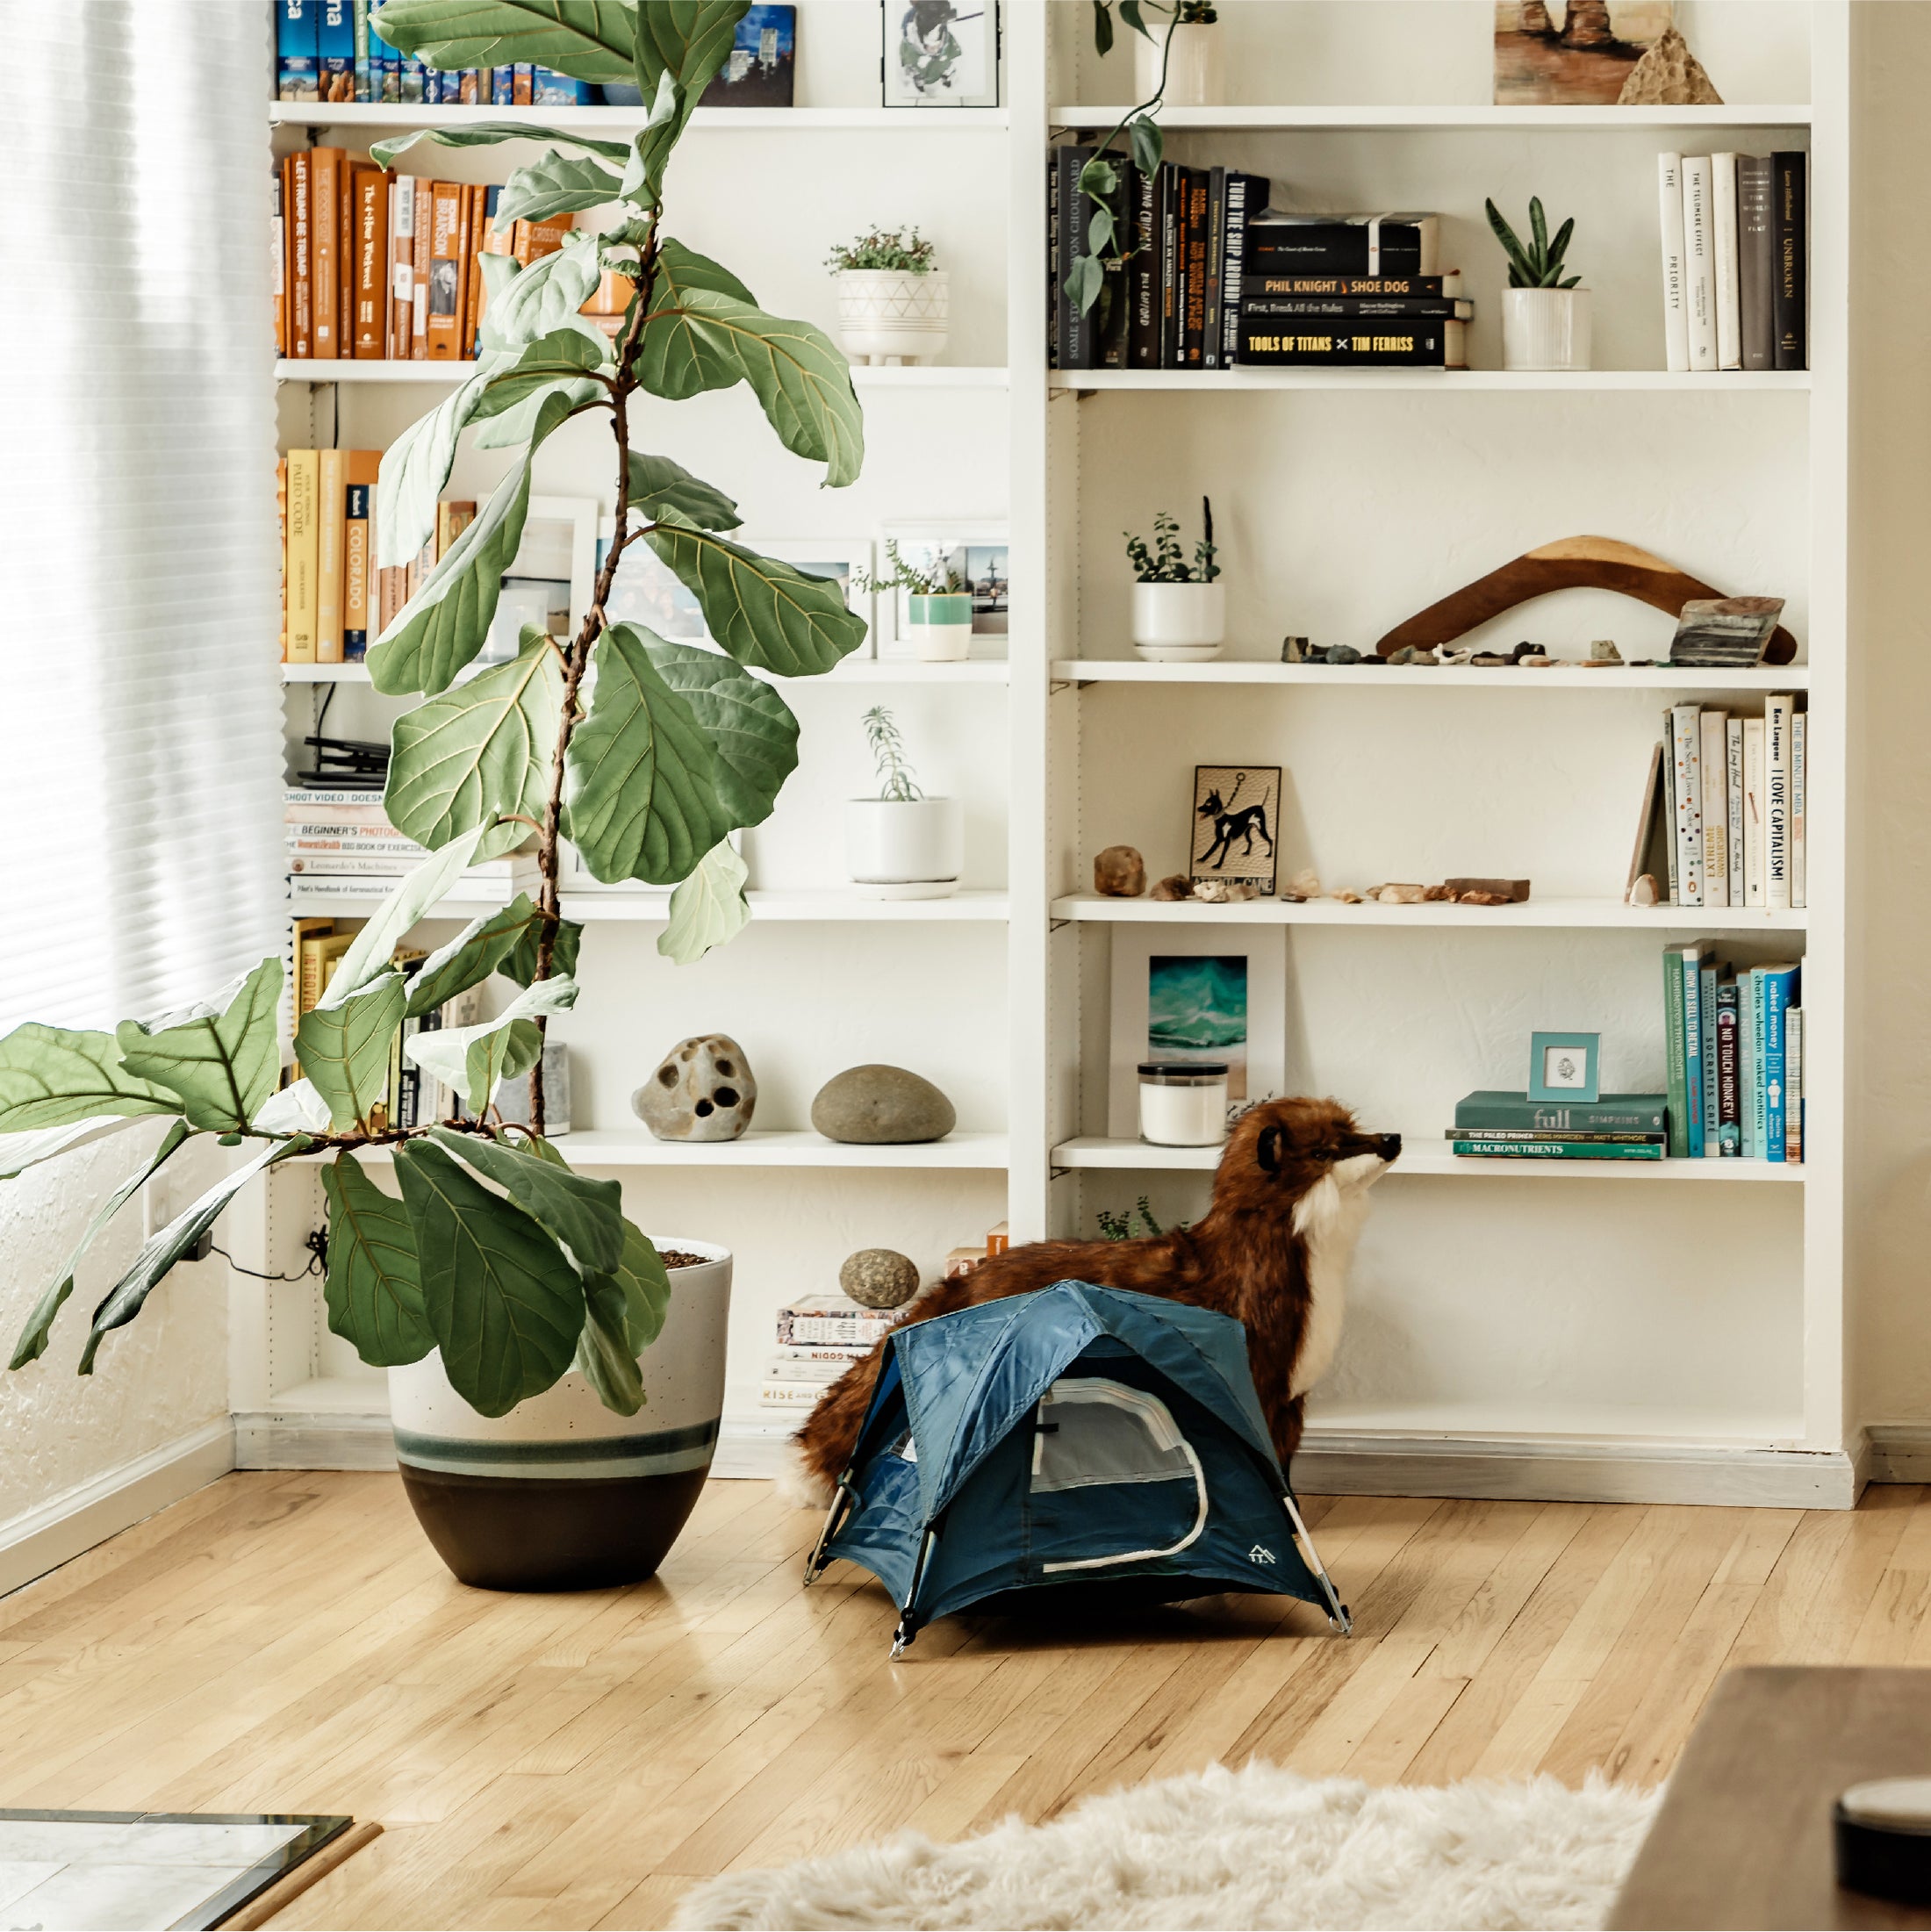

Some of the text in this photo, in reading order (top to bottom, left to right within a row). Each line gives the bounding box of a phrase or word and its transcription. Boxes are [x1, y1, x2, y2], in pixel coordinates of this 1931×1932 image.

[296, 161, 307, 179] LET
[295, 181, 307, 219] TRUMP
[364, 184, 376, 204] The
[1139, 173, 1152, 207] SPRING
[363, 205, 376, 239] 4-Hour
[1190, 189, 1199, 228] MANSON
[296, 221, 307, 237] BE
[319, 219, 328, 243] GUT
[434, 198, 449, 255] BRANSON
[1666, 169, 1679, 309] THE PRIORITY
[296, 238, 307, 277] TRUMP
[1166, 248, 1173, 256] AN
[1224, 182, 1245, 304] TURN THE SHIP AROUND!
[1694, 230, 1703, 256] EFFECT
[363, 241, 374, 291] Workweek
[1069, 159, 1080, 360] SOME CHOUINARD
[1784, 238, 1792, 298] UNBROKEN
[1188, 263, 1197, 293] GIVING
[1266, 281, 1337, 292] PHIL KNIGHT
[1351, 281, 1410, 293] SHOE DOG
[1248, 304, 1268, 313] First,
[1294, 304, 1305, 312] All
[1249, 337, 1332, 351] TOOLS OF TITANS
[1352, 337, 1414, 351] TIM FERRISS
[293, 463, 304, 537] PALEO CODE
[349, 526, 362, 609] COLORADO
[1772, 708, 1782, 762] Ken Langone
[1794, 741, 1802, 751] 80
[314, 794, 344, 802] VIDEO
[1685, 776, 1694, 794] Lives
[1771, 776, 1784, 805] LOVE
[302, 825, 357, 835] BEGINNER'S
[1771, 808, 1784, 880] CAPITALISM!
[311, 860, 397, 871] Leonardo's Machines
[1705, 825, 1715, 878] EXTREME
[1715, 825, 1725, 878] OWNERSHIP
[1740, 985, 1748, 1010] WHY
[1755, 974, 1764, 1052] charles wheelan
[1769, 981, 1780, 1013] naked
[1672, 968, 1683, 1080] HASHIMOTO'S THYROIDITIS
[1685, 970, 1698, 1058] HOW TO SELL TO RETAIL
[1767, 1015, 1778, 1048] money
[1705, 1037, 1717, 1132] SOCRATES CAFÉ
[1720, 1028, 1734, 1118] NO TOUCH MONKEY!
[1755, 1058, 1766, 1130] naked statistics
[1534, 1110, 1570, 1130] full
[1473, 1144, 1563, 1154] MACRONUTRIENTS
[811, 1352, 843, 1361] GODIN
[763, 1390, 793, 1399] RISE
